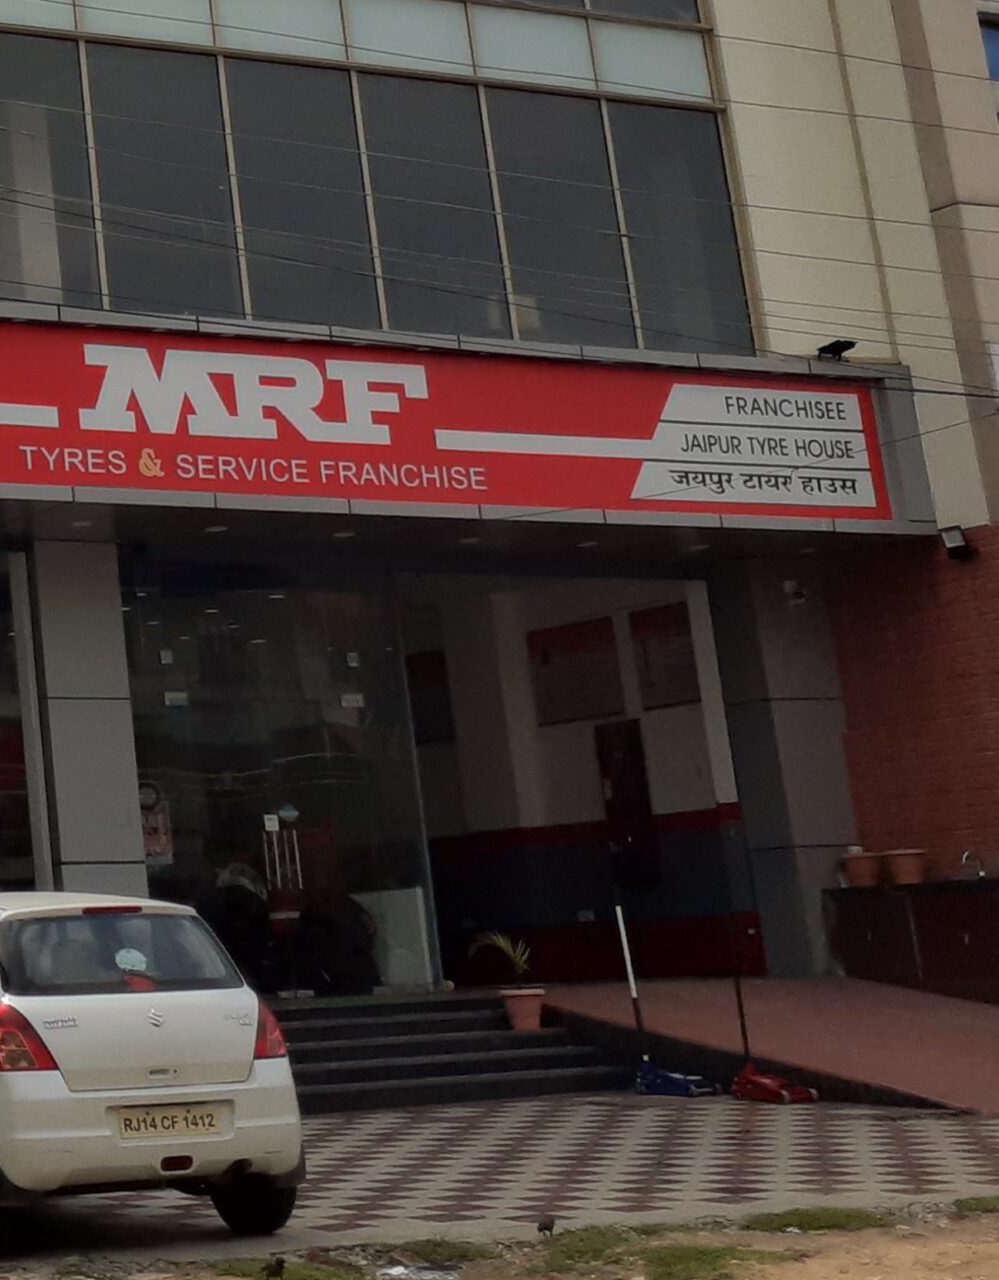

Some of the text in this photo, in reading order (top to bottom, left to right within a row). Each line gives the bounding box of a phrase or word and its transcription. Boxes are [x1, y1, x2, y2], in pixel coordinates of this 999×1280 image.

[79, 343, 429, 445] MRF
[724, 395, 848, 422] FRANCHISEE
[680, 431, 855, 460] JAIPUR TYRE HOUSE
[18, 444, 489, 491] TYRES & SERVICE FRANCHISE
[669, 467, 859, 497] जयपुर टायर हाउस
[123, 1112, 216, 1133] RJ14 CF 1412
